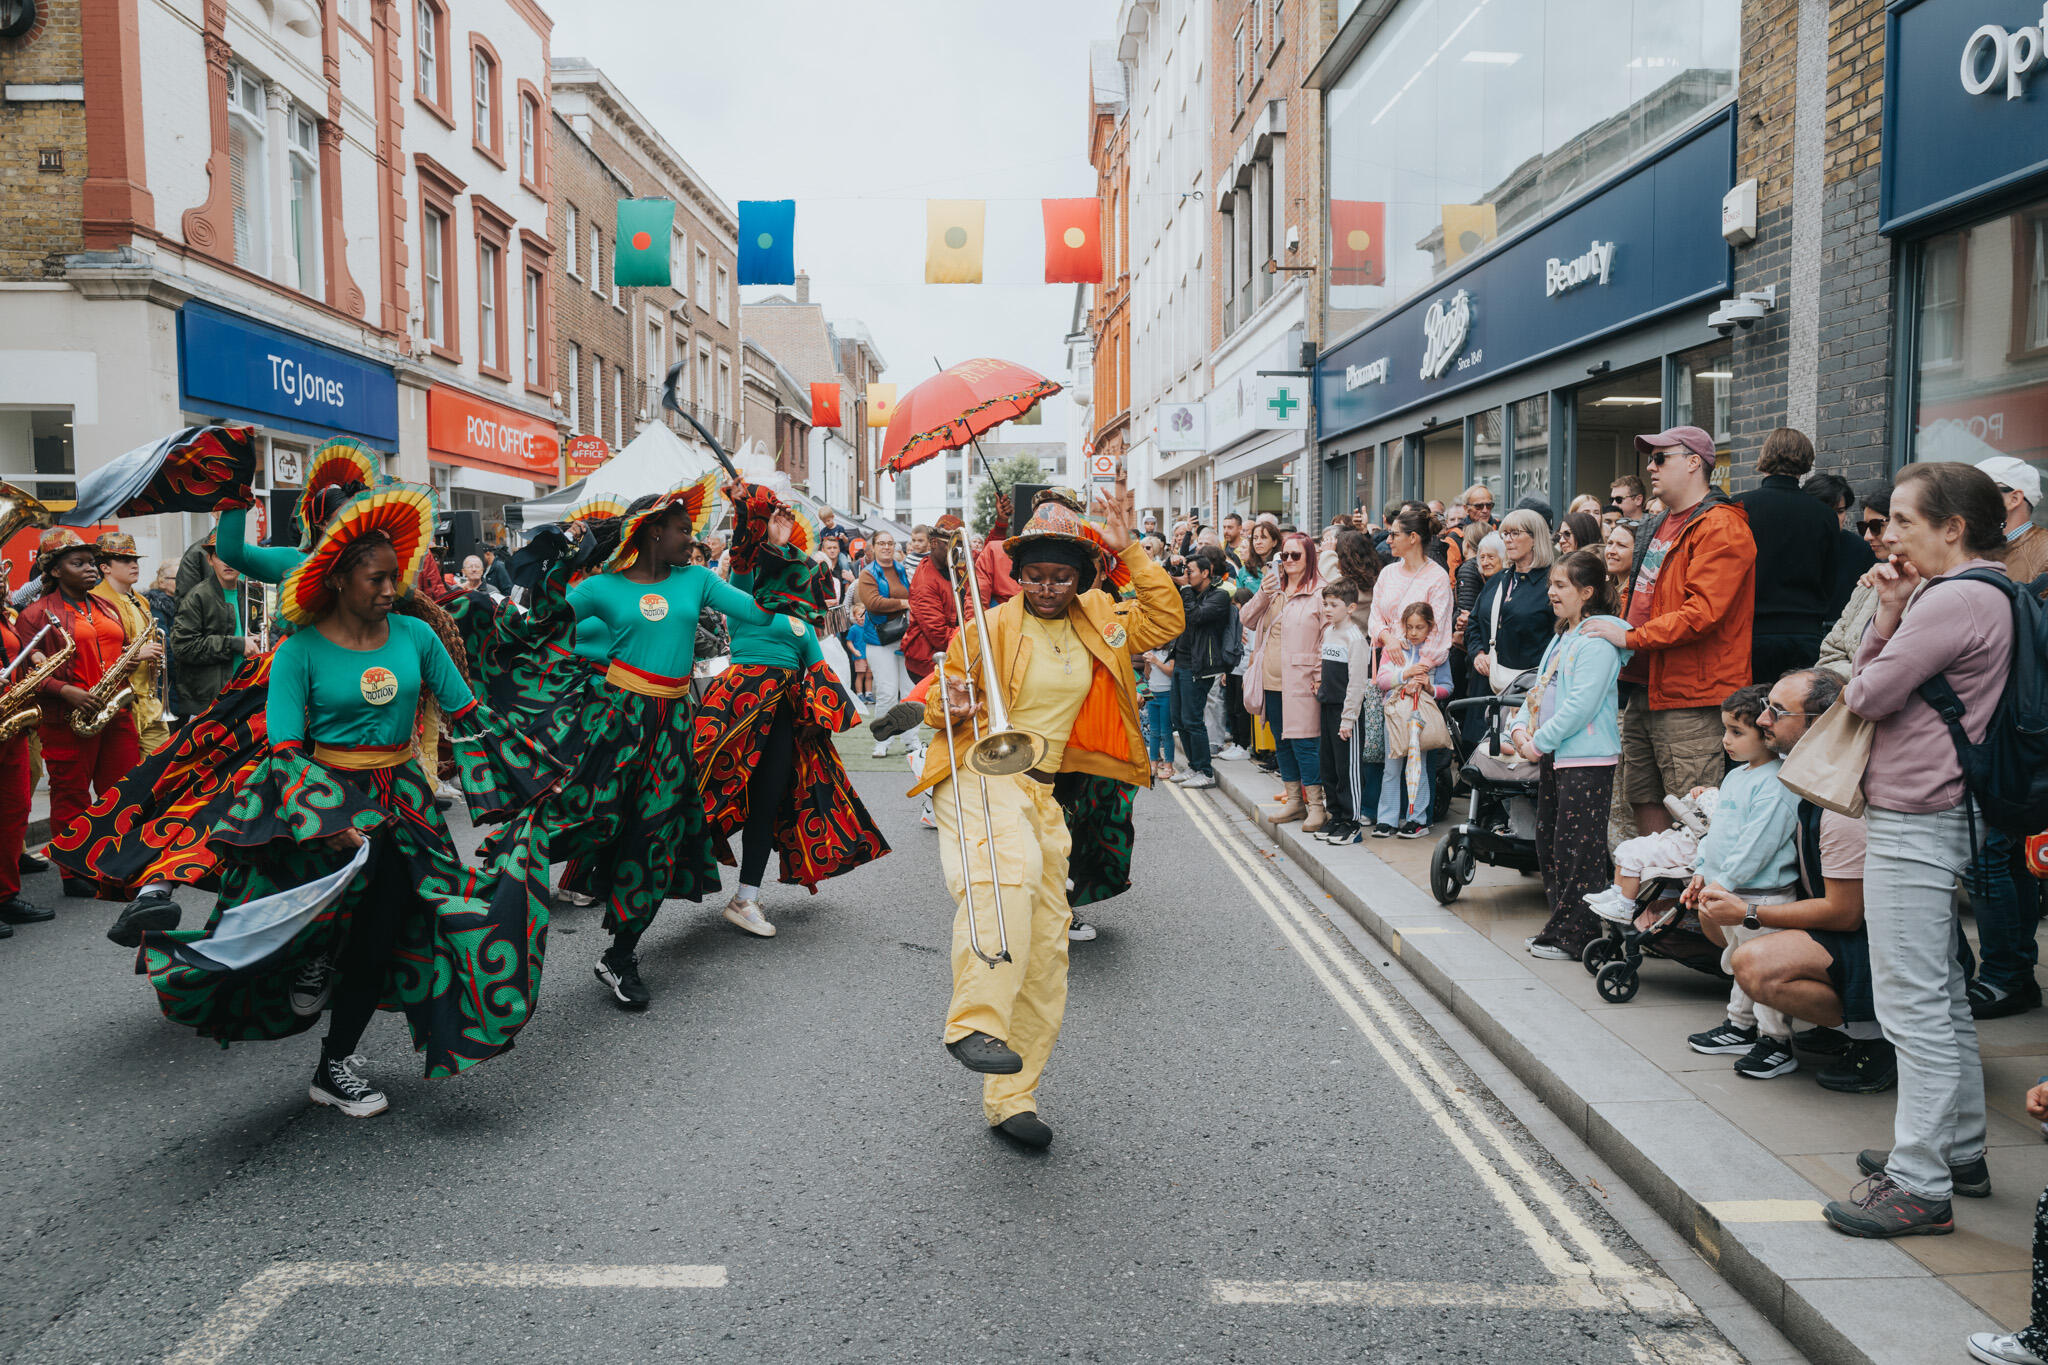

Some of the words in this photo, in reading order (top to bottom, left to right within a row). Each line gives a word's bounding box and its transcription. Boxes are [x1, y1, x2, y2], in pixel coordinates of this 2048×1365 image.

[1546, 240, 1615, 297] Beauty
[1420, 289, 1469, 380] Boots
[1458, 357, 1470, 371] Since
[1471, 349, 1482, 366] 1849
[1346, 357, 1388, 392] Pharmacy
[467, 415, 497, 449] POST
[498, 425, 535, 459] OFFICE
[577, 441, 600, 450] POST
[571, 450, 604, 458] OFFICE
[365, 687, 394, 700] MOTION
